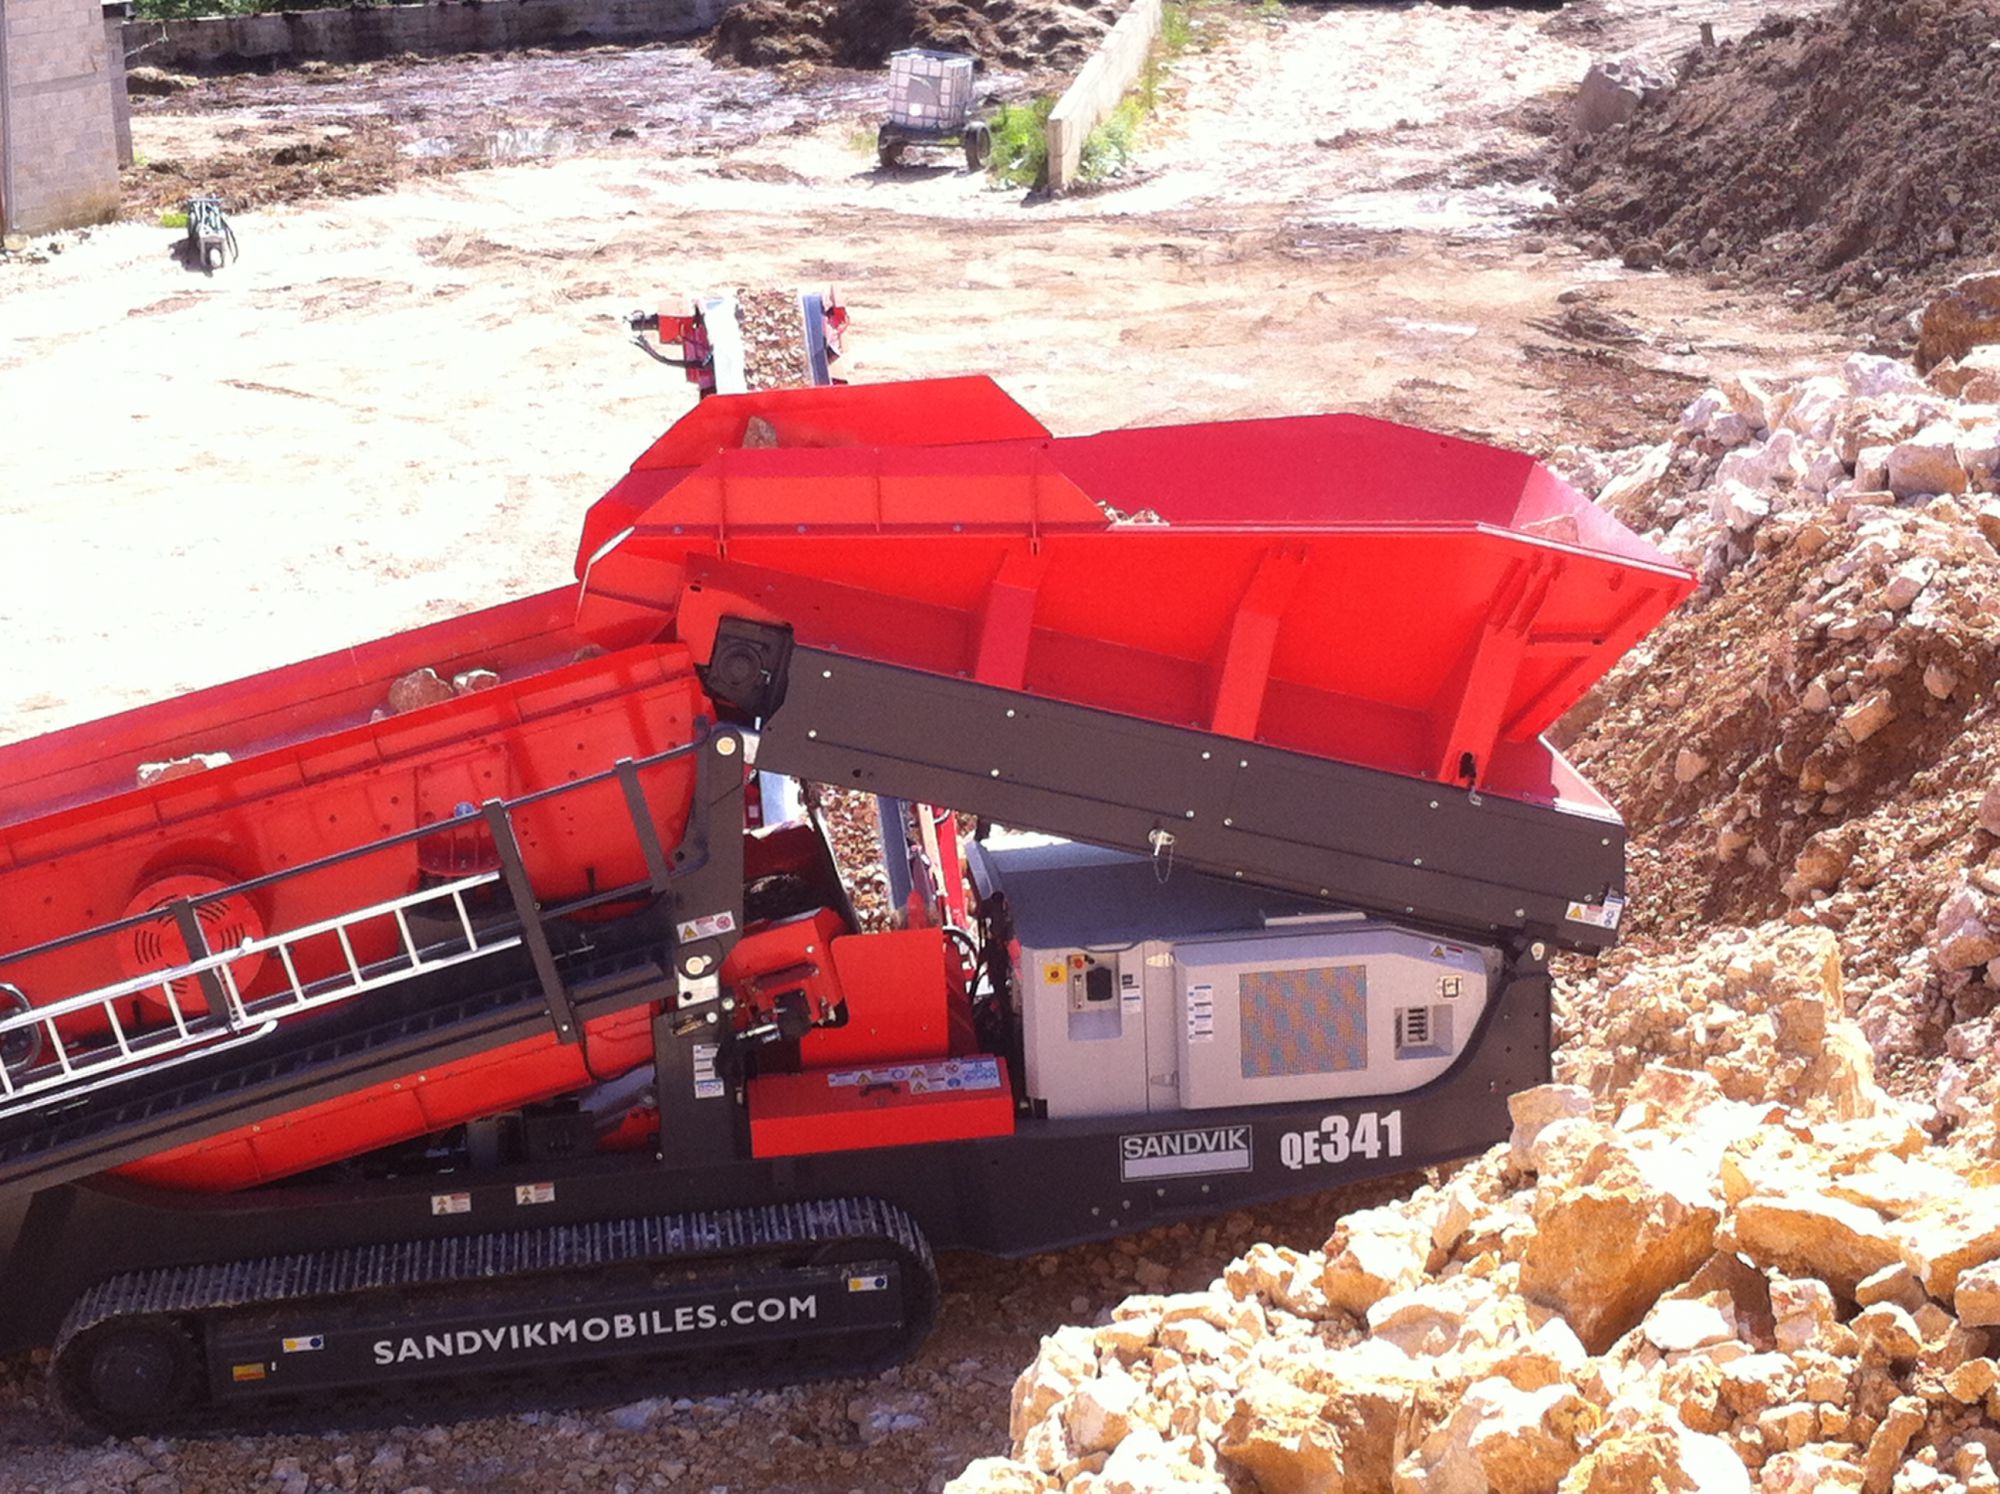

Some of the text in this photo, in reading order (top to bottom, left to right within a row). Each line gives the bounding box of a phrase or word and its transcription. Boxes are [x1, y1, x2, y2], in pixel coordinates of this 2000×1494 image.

[1123, 1128, 1248, 1160] SANDVIK
[1280, 1110, 1402, 1170] QE341
[373, 1295, 818, 1366] SANDVIKMOBILES.COM
